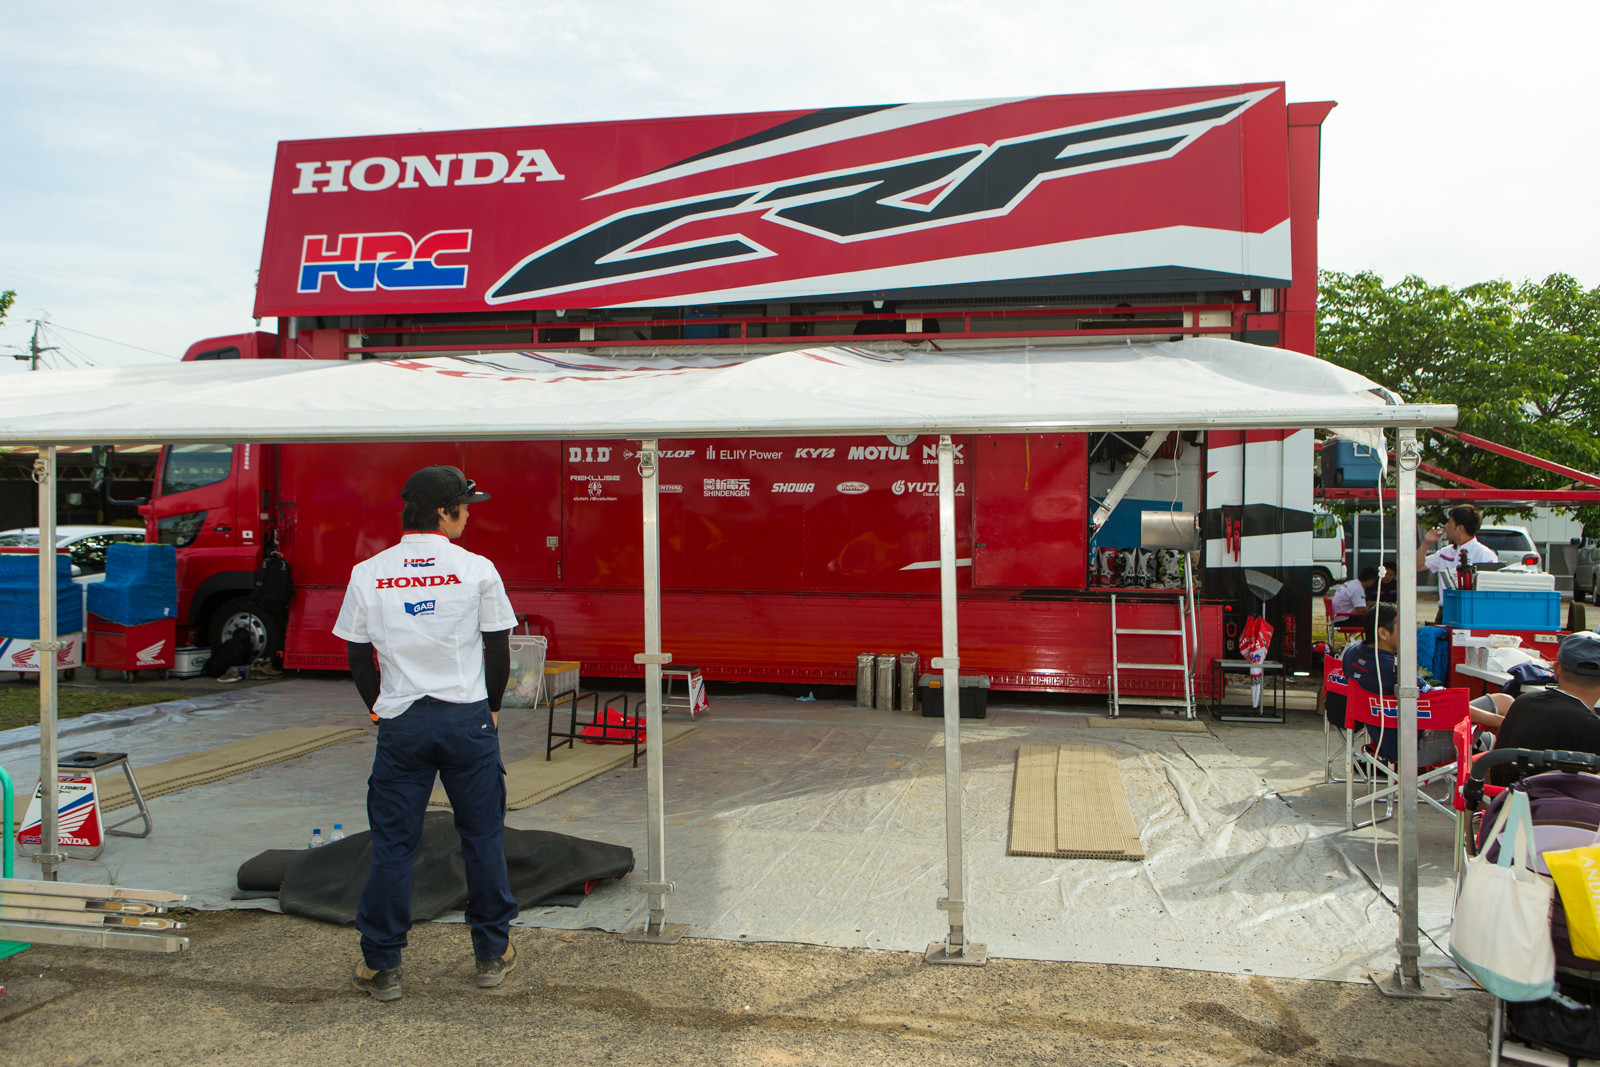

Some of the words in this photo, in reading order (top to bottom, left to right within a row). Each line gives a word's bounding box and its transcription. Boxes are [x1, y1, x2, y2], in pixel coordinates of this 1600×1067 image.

[292, 148, 565, 195] HONDA
[297, 229, 473, 294] HRC
[749, 449, 783, 460] Power
[795, 447, 836, 459] KYB
[848, 446, 910, 461] MOTUL
[922, 443, 965, 459] NK
[703, 489, 750, 497] SHINDENGEN
[771, 482, 816, 493] SHOWA
[404, 558, 436, 568] HRC
[376, 574, 461, 589] HONDA
[414, 602, 434, 612] GAS
[136, 658, 166, 666] HONDA
[58, 837, 91, 845] ONDA
